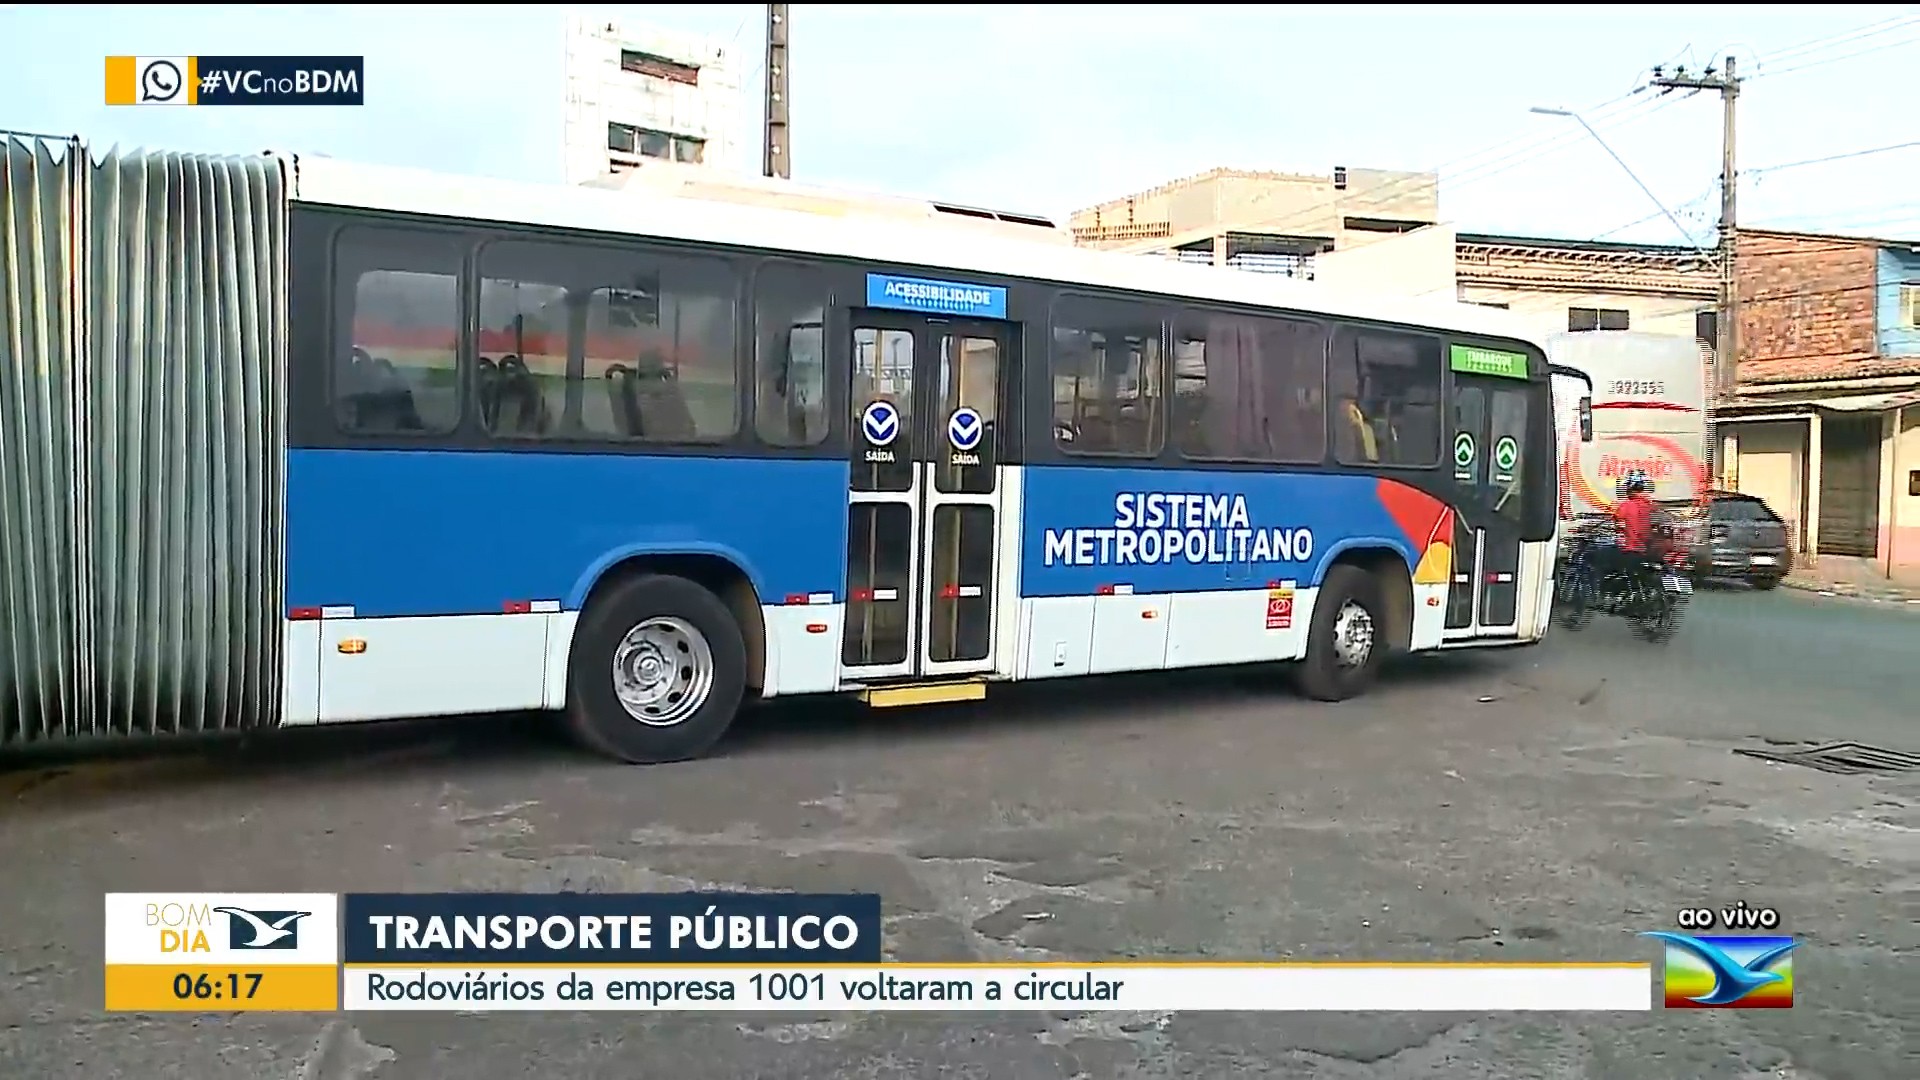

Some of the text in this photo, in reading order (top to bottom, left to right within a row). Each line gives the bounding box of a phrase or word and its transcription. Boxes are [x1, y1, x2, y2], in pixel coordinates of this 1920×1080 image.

[884, 281, 991, 305] ACESSIBILIDADE
[864, 448, 896, 463] SAÍDA
[951, 452, 981, 467] SAÍDA
[1114, 494, 1249, 529] SISTEMA
[1044, 528, 1313, 566] METROPOLITANO
